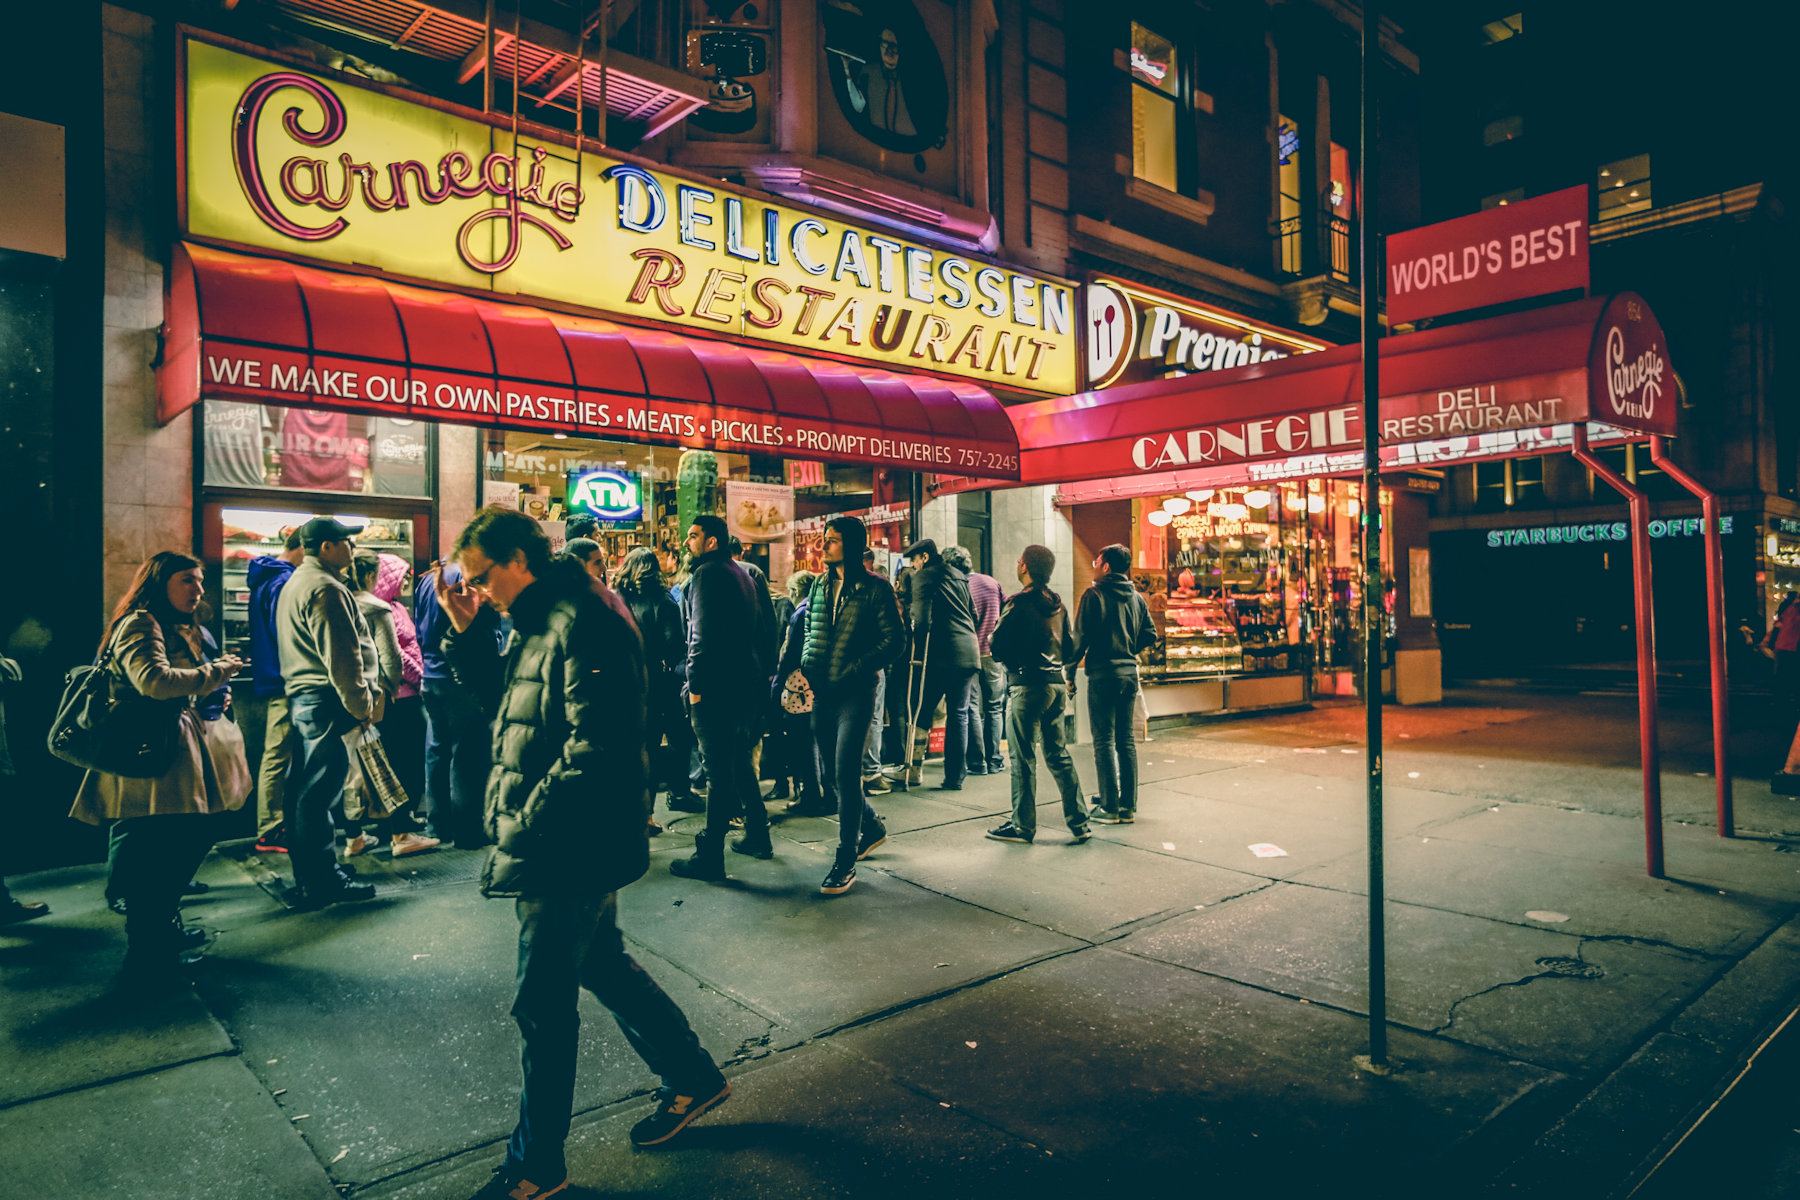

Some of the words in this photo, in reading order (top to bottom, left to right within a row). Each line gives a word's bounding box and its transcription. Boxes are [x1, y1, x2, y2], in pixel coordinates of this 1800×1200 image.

[231, 71, 586, 274] Carnegie
[599, 164, 1070, 336] DELICATESSEN
[1391, 240, 1503, 295] WORLD'S
[1510, 220, 1582, 270] BEST
[626, 247, 1057, 381] RESTAURANT
[1140, 306, 1288, 371] Premi
[1437, 385, 1497, 413] DELI
[1605, 326, 1664, 420] Carnegie
[208, 356, 262, 388] WE
[270, 363, 359, 399] MAKE
[365, 375, 428, 406] OUR
[434, 383, 501, 414] OWN
[506, 392, 611, 427] PASTRIES
[627, 408, 695, 437] MEATS
[711, 419, 784, 446] PICKLES
[796, 428, 866, 455] PROMPT
[870, 438, 952, 464] DELIVERIES
[958, 449, 1018, 472] 757-2245
[1131, 404, 1362, 470] CARNEGIE
[1383, 398, 1563, 440] RESTAURANT
[571, 480, 638, 508] ATM
[789, 460, 821, 488] EXIT
[1487, 522, 1628, 548] STARBUCKS
[1647, 516, 1733, 539] OFFE
